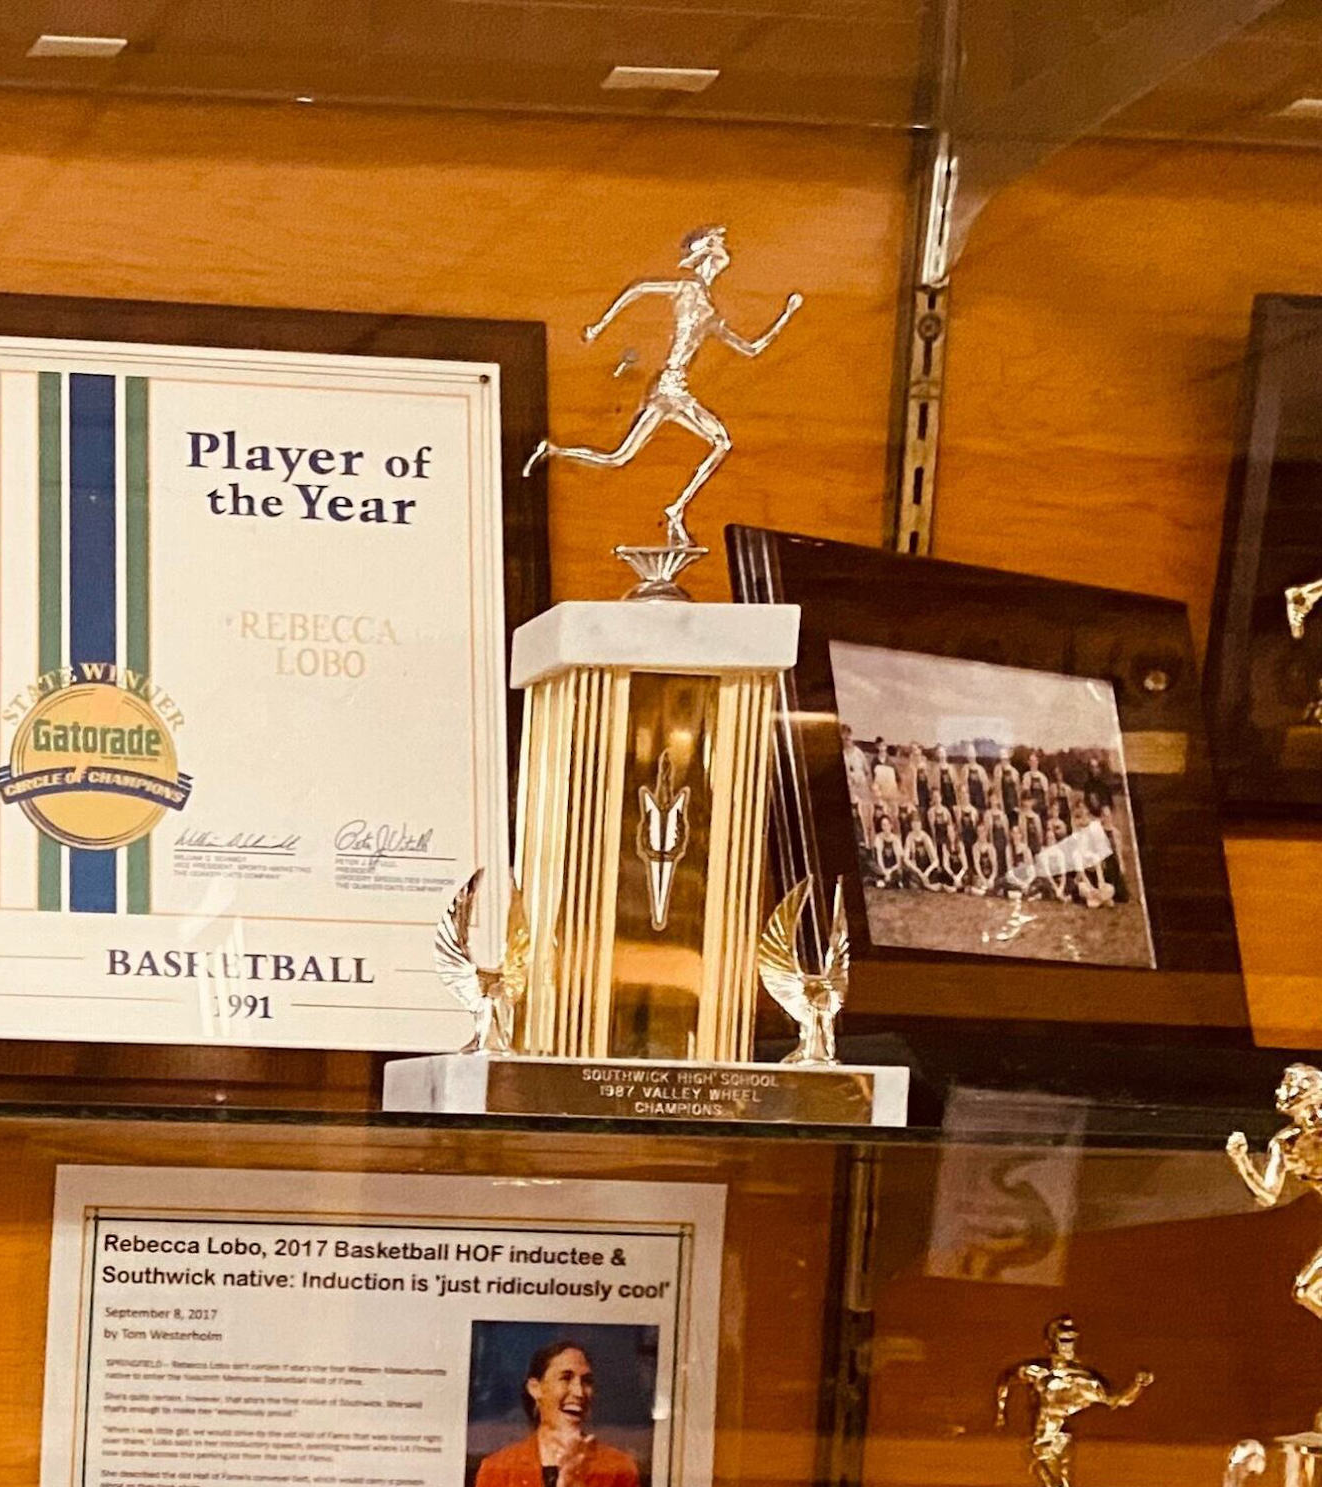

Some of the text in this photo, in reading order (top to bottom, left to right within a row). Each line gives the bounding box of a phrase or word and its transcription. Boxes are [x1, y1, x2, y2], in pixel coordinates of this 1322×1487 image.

[186, 431, 432, 482] Player of
[208, 483, 416, 525] the Year
[241, 610, 401, 646] REBECCA
[276, 646, 365, 678] LOBO
[2, 662, 185, 732] STATE WINNER
[32, 719, 163, 757] Gatorade
[4, 770, 185, 804] CIRCLE OF CHAMPIONS
[107, 948, 375, 984] BASKETBALL
[213, 994, 274, 1019] 1991
[582, 1069, 779, 1087] SOUTHWICK HIGH SCHOOL
[600, 1085, 762, 1103] 1987 VALLEY WHEEL
[635, 1101, 722, 1116] CHAMPIONS
[104, 1234, 627, 1266] Rebecca Lobo, 2017 Basketball HOF inductee &
[102, 1266, 670, 1302] Southwick native: Induction is 'just ridiculously cool'
[105, 1307, 170, 1321] September
[188, 1309, 217, 1320] 2017
[104, 1328, 222, 1341] by Tom Westerholm
